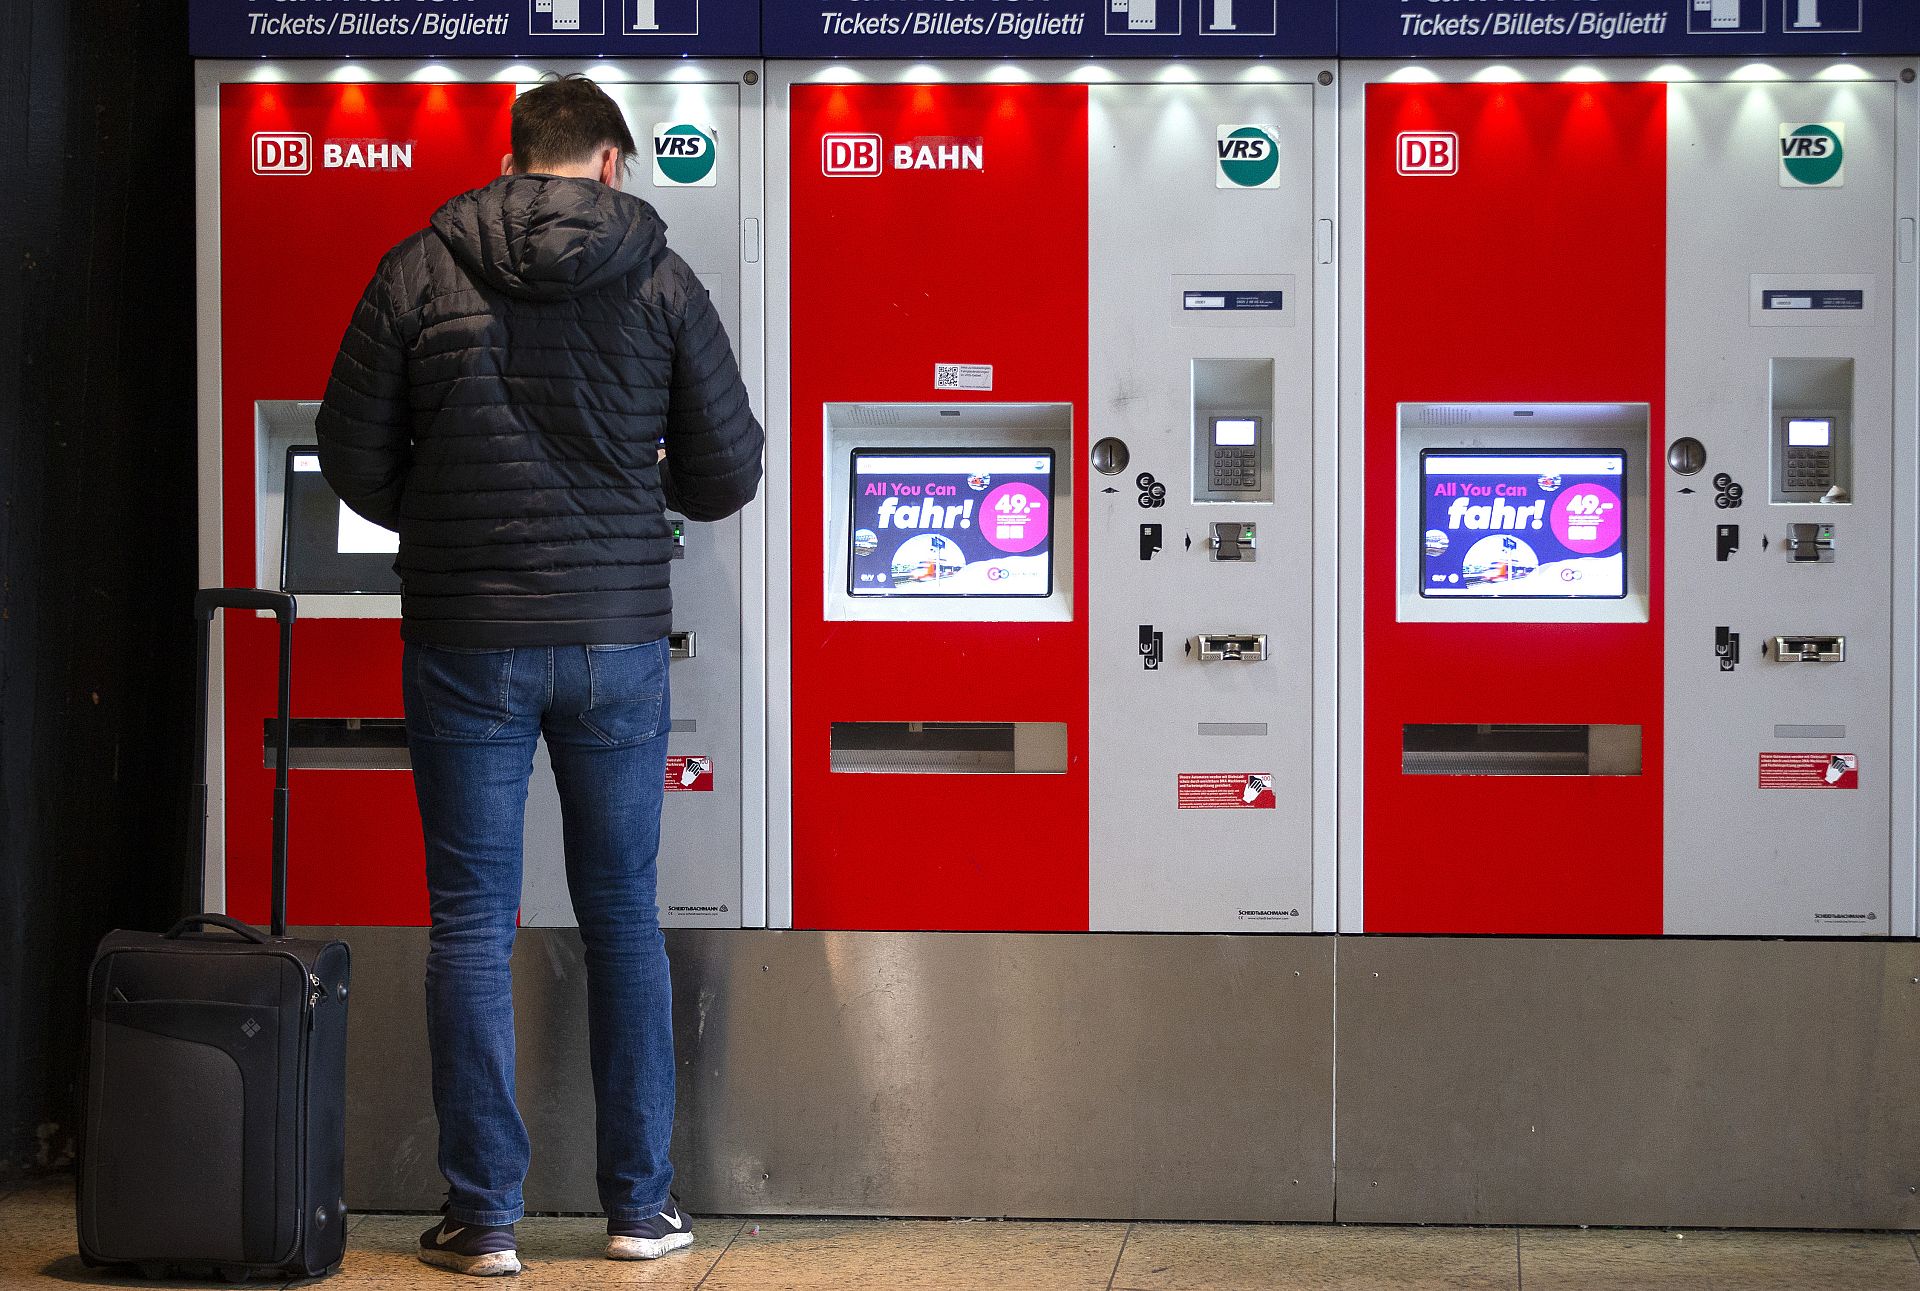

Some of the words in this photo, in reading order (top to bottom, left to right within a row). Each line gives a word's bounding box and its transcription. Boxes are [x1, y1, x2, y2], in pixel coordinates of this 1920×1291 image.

[260, 141, 304, 168] DB
[324, 143, 413, 168] BAHN
[654, 136, 700, 157] VRS
[830, 141, 875, 170] DB
[894, 144, 983, 170] BAHN
[1217, 139, 1264, 160] VRS
[1405, 140, 1449, 168] DB
[1780, 136, 1828, 157] VRS
[865, 482, 887, 496] All
[891, 482, 921, 496] You
[925, 483, 956, 496] Can
[1434, 482, 1457, 496] All
[1460, 483, 1491, 497] You
[1495, 484, 1528, 497] Can
[877, 497, 974, 529] fahr!
[1447, 497, 1546, 530] fahr!
